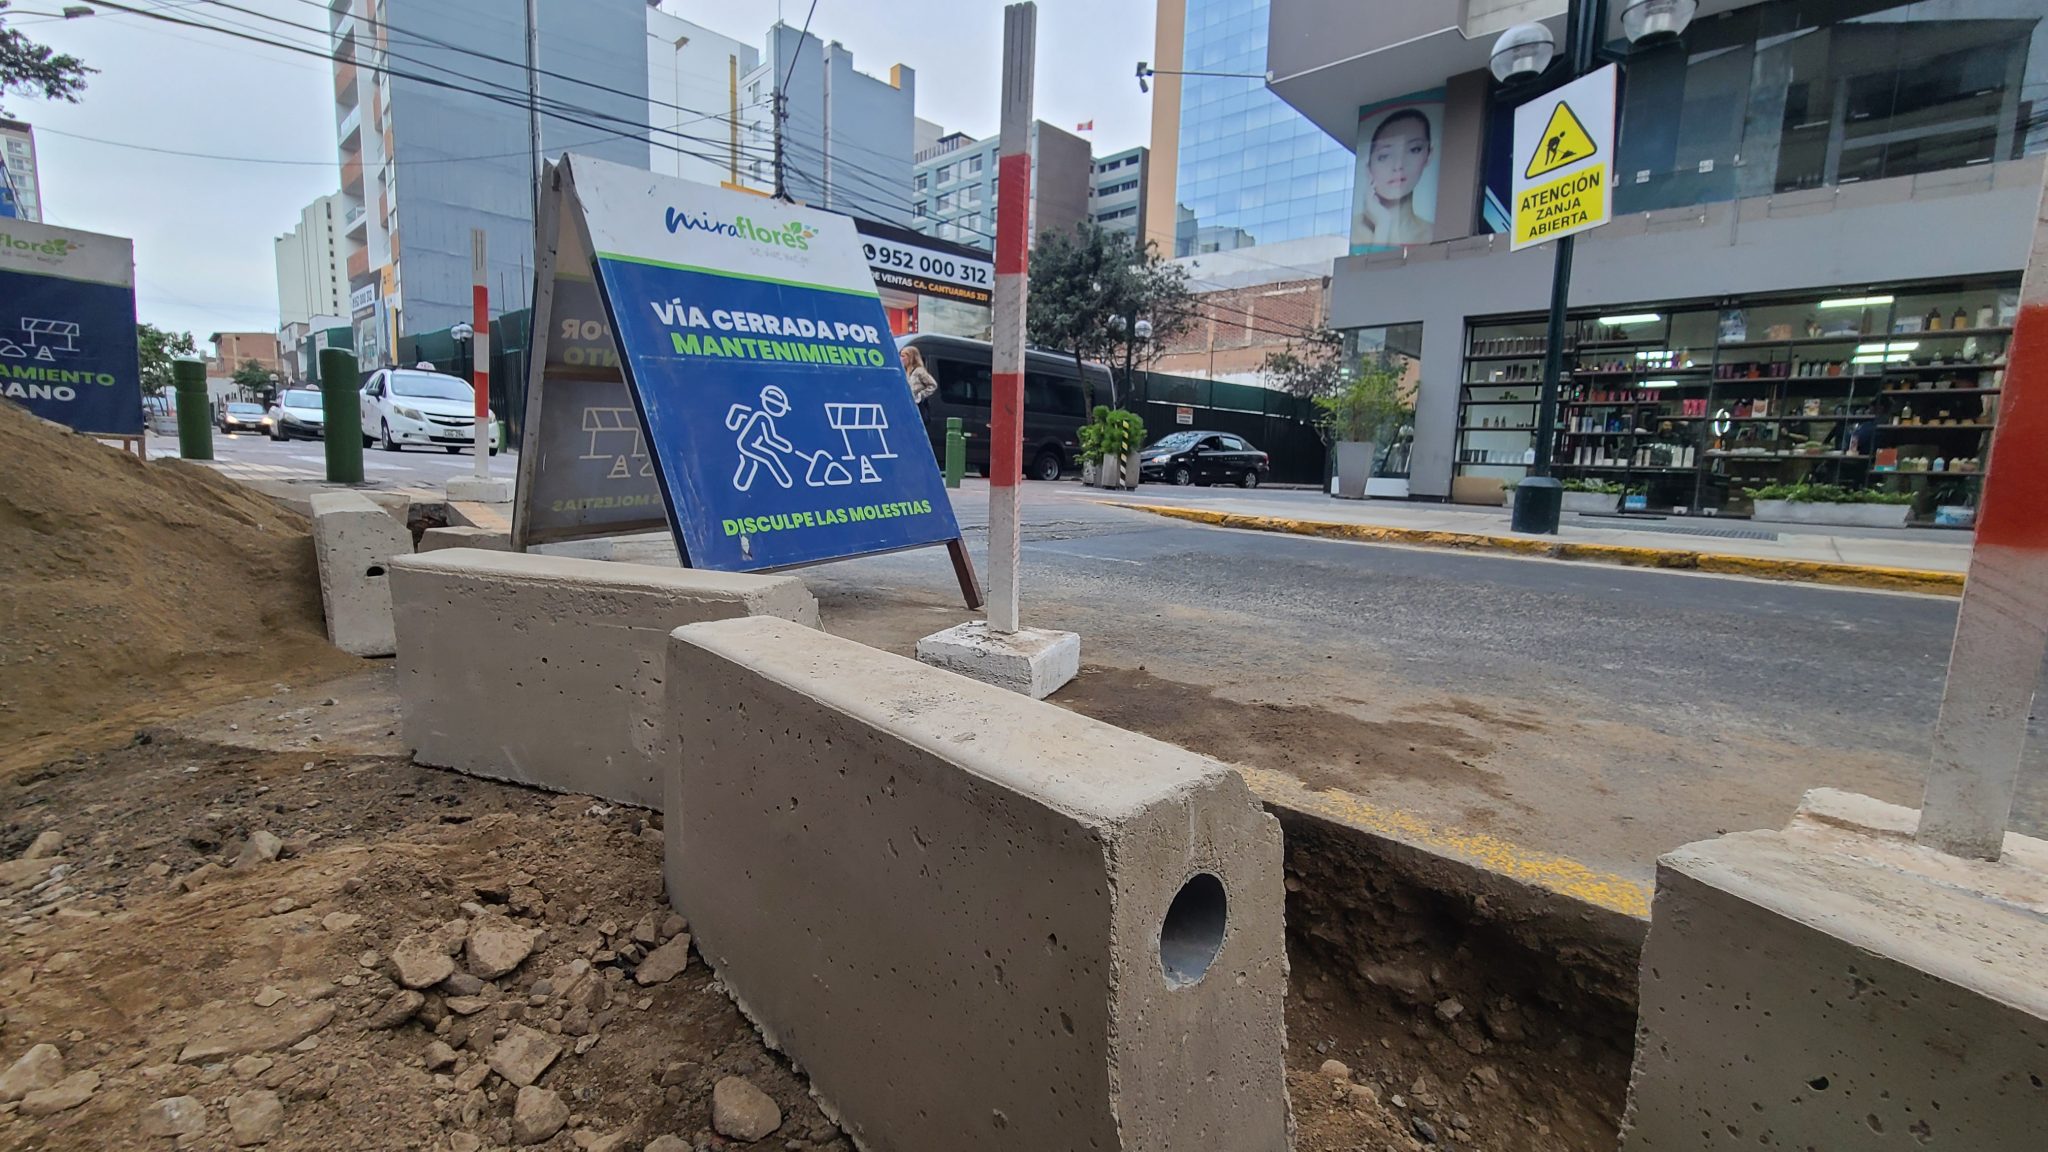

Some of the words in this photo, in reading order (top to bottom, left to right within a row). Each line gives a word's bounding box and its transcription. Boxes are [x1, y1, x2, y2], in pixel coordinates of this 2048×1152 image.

[1521, 172, 1600, 212] ATENCIÓN
[1536, 197, 1581, 220] ZANJA
[665, 206, 808, 251] miraflores
[1529, 210, 1588, 238] ABIERTA
[879, 247, 914, 270] 952
[920, 256, 955, 278] 000
[960, 264, 987, 284] 312
[881, 273, 913, 287] VENTAS
[913, 280, 928, 290] CA.
[928, 283, 976, 300] CANTUARIAS
[650, 297, 711, 329] VÍA
[711, 309, 835, 341] CERRADA
[834, 322, 881, 344] POR
[670, 332, 885, 367] MANTENIMIENTO
[0, 381, 77, 402] ANO
[722, 512, 815, 536] DISCULPE
[814, 508, 849, 526] LAS
[848, 500, 932, 522] MOLESTIAS
